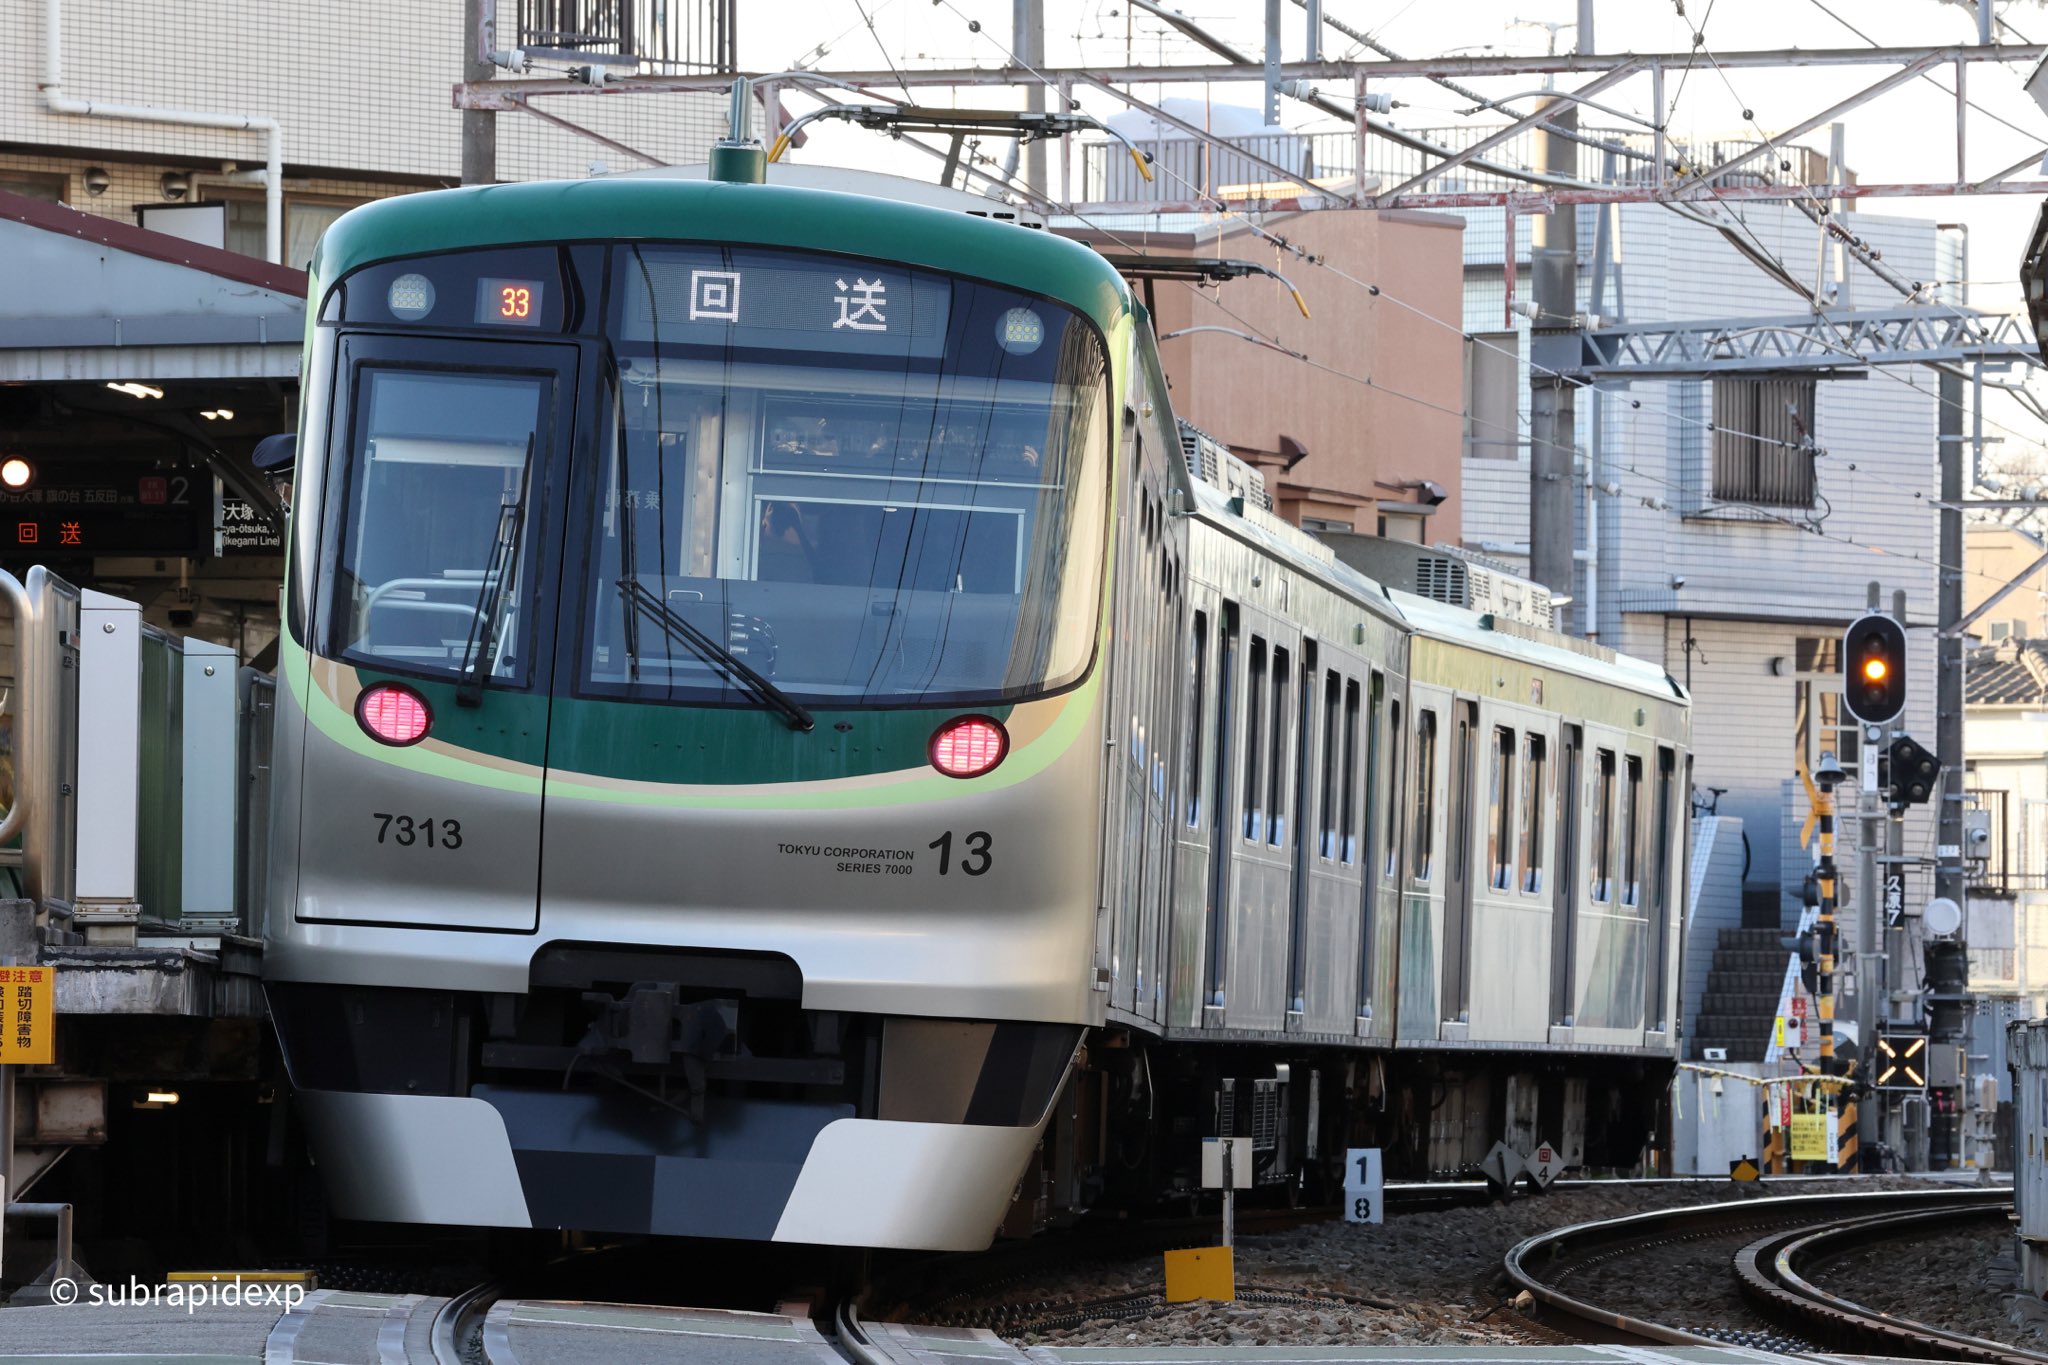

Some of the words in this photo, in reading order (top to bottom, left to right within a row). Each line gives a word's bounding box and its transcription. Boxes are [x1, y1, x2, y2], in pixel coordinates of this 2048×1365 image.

[501, 286, 531, 318] 33
[689, 269, 888, 332] 回送
[170, 475, 190, 505] 2
[18, 521, 82, 544] 回送
[373, 812, 463, 850] 7313
[777, 843, 821, 856] TOKYU
[823, 846, 914, 861] CORPORATION
[928, 830, 993, 877] 13
[836, 862, 881, 874] SERIES
[884, 864, 913, 875] 7000
[16, 985, 33, 1048] 踏切障害物
[1356, 1155, 1368, 1185] 1
[1538, 1165, 1549, 1182] 4
[1354, 1197, 1371, 1219] 8
